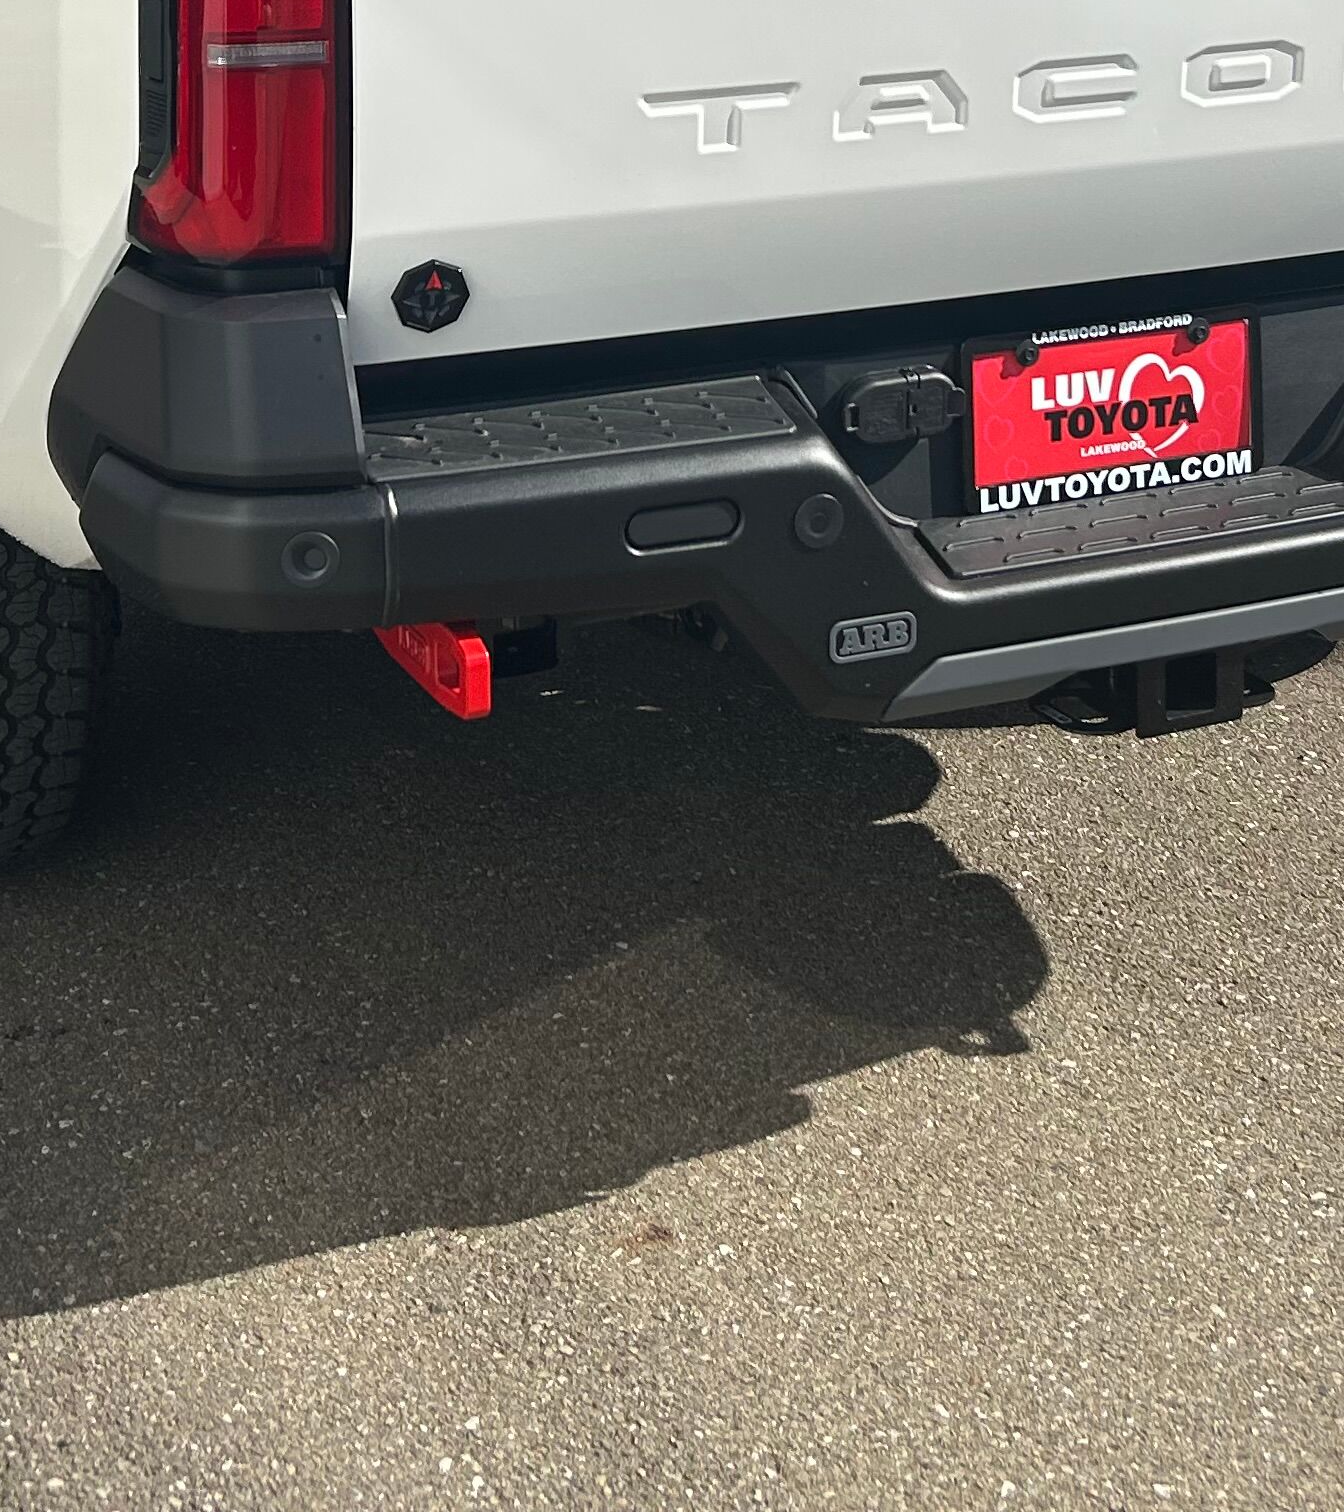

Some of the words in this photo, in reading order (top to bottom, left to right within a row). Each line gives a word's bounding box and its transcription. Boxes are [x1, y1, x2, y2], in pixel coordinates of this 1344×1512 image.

[1032, 324, 1109, 345] LAKEWOOD
[1119, 314, 1193, 335] BRADFORD
[1032, 368, 1115, 410] LUV
[1045, 394, 1198, 442] TOYOTA
[1080, 438, 1146, 458] LAKEWOOD
[980, 450, 1252, 513] LUVTOYOTA.COM
[839, 620, 909, 656] ARB
